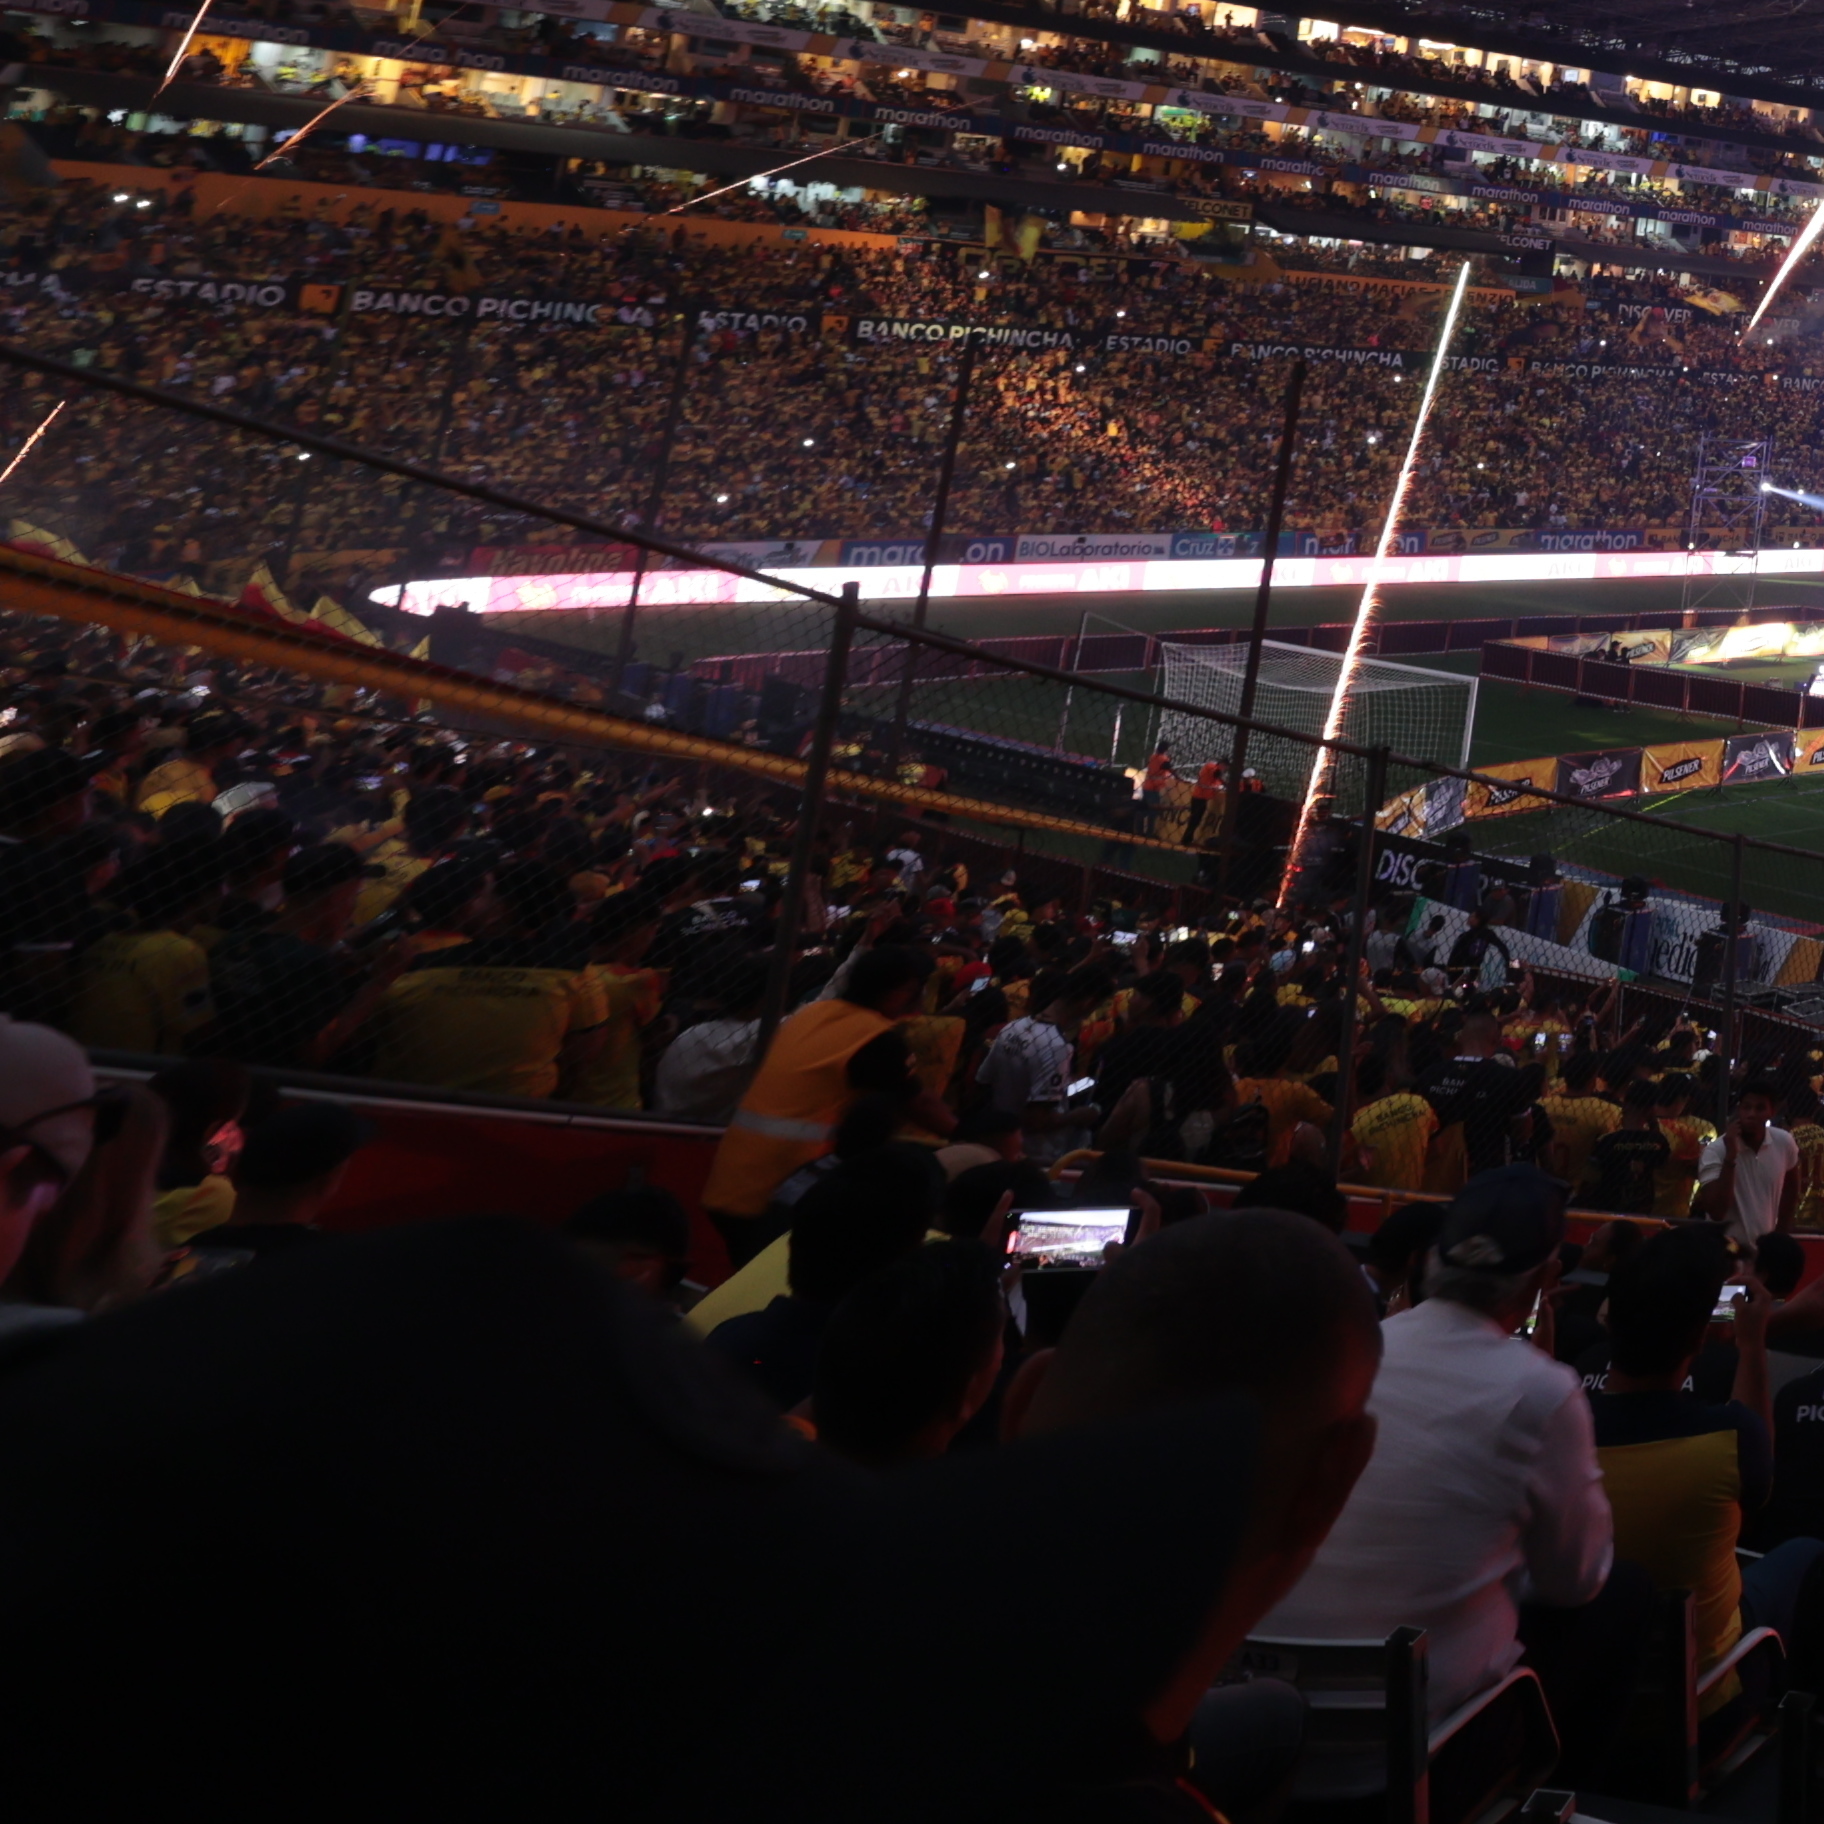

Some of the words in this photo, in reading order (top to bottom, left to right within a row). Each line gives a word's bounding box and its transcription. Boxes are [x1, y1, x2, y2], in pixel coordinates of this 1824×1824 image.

[372, 41, 505, 70] marahon
[563, 65, 678, 92] marathon
[730, 87, 834, 112] marathon
[875, 107, 970, 131] marathon
[1015, 125, 1103, 148] marathon
[1143, 142, 1225, 163] marathon
[1261, 157, 1325, 176] maratho
[1370, 171, 1439, 191] marathon
[1472, 185, 1538, 203] marathon
[1569, 197, 1630, 215] marathon
[1658, 209, 1716, 225] marathon
[1743, 220, 1798, 235] marathon
[1500, 235, 1552, 251] ELCONET
[1508, 279, 1537, 290] ALIDA
[350, 289, 471, 317] BANCO
[476, 297, 655, 326] PICHINCA
[857, 319, 944, 342] BANCO
[1105, 334, 1191, 355] ESTADIO
[1440, 355, 1498, 372] STADIO
[1175, 538, 1215, 556] Cruz
[1541, 529, 1639, 550] marathon
[848, 541, 1005, 565] maraon
[1661, 758, 1701, 783] PILSENER
[1745, 759, 1770, 775] PILSENER
[1579, 776, 1611, 795] PILSENER
[1652, 931, 1697, 980] edic
